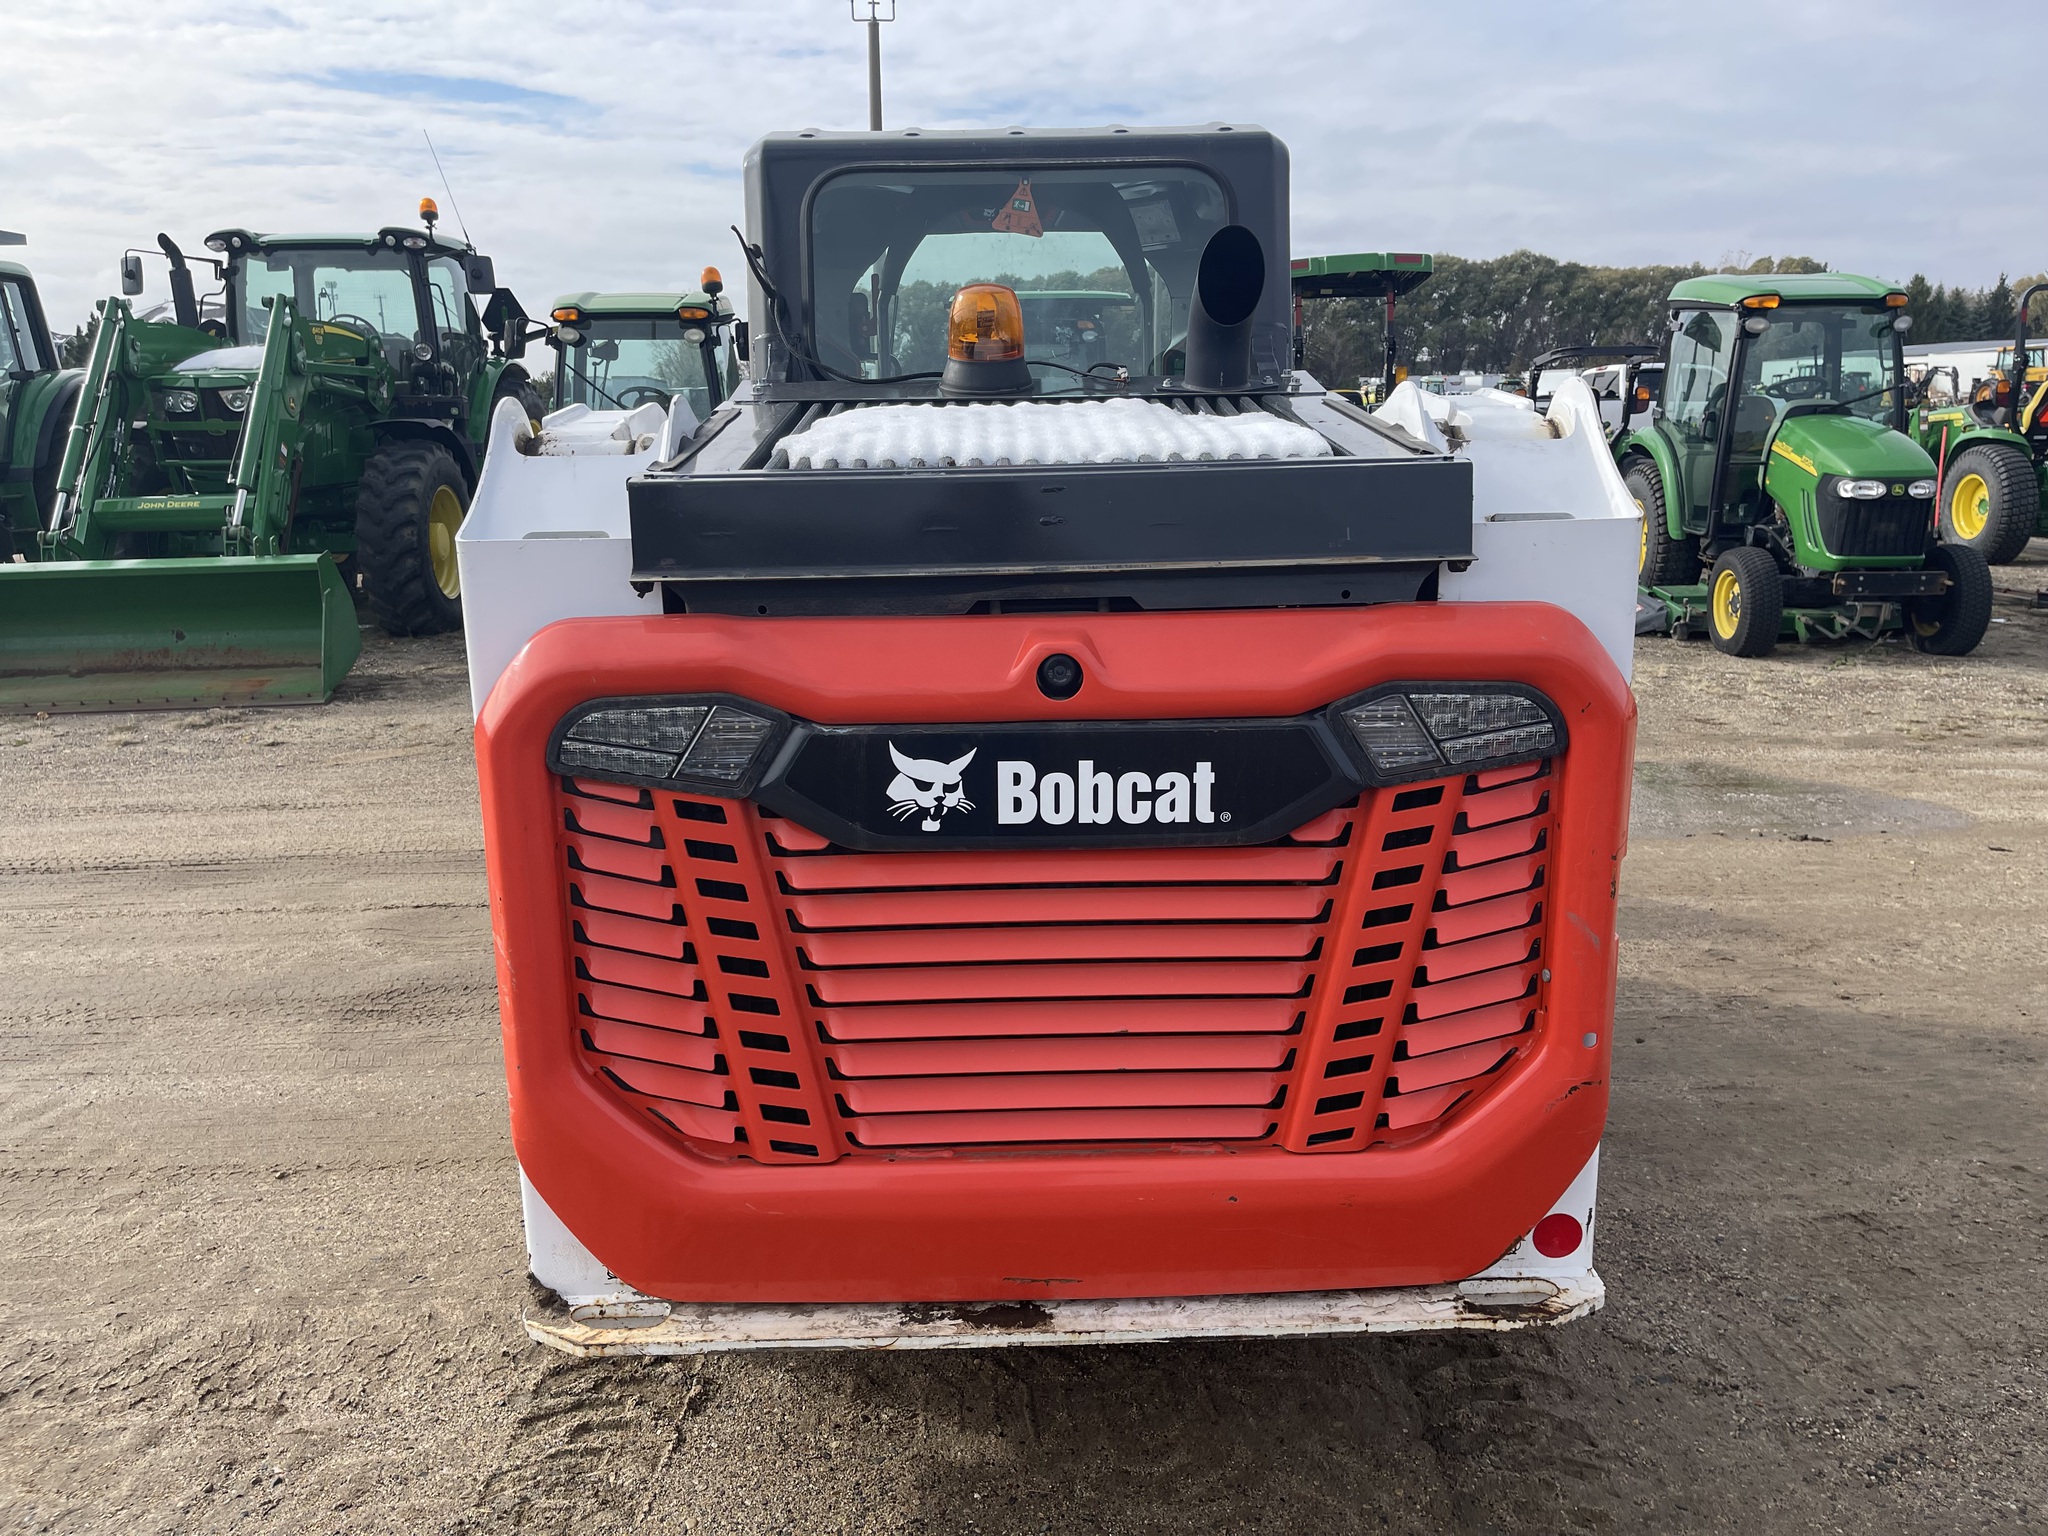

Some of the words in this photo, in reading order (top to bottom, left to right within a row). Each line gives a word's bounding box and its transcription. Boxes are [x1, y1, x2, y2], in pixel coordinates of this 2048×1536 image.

[137, 501, 165, 509] JOHN
[167, 500, 200, 508] DEERE
[997, 760, 1216, 825] Bobcat
